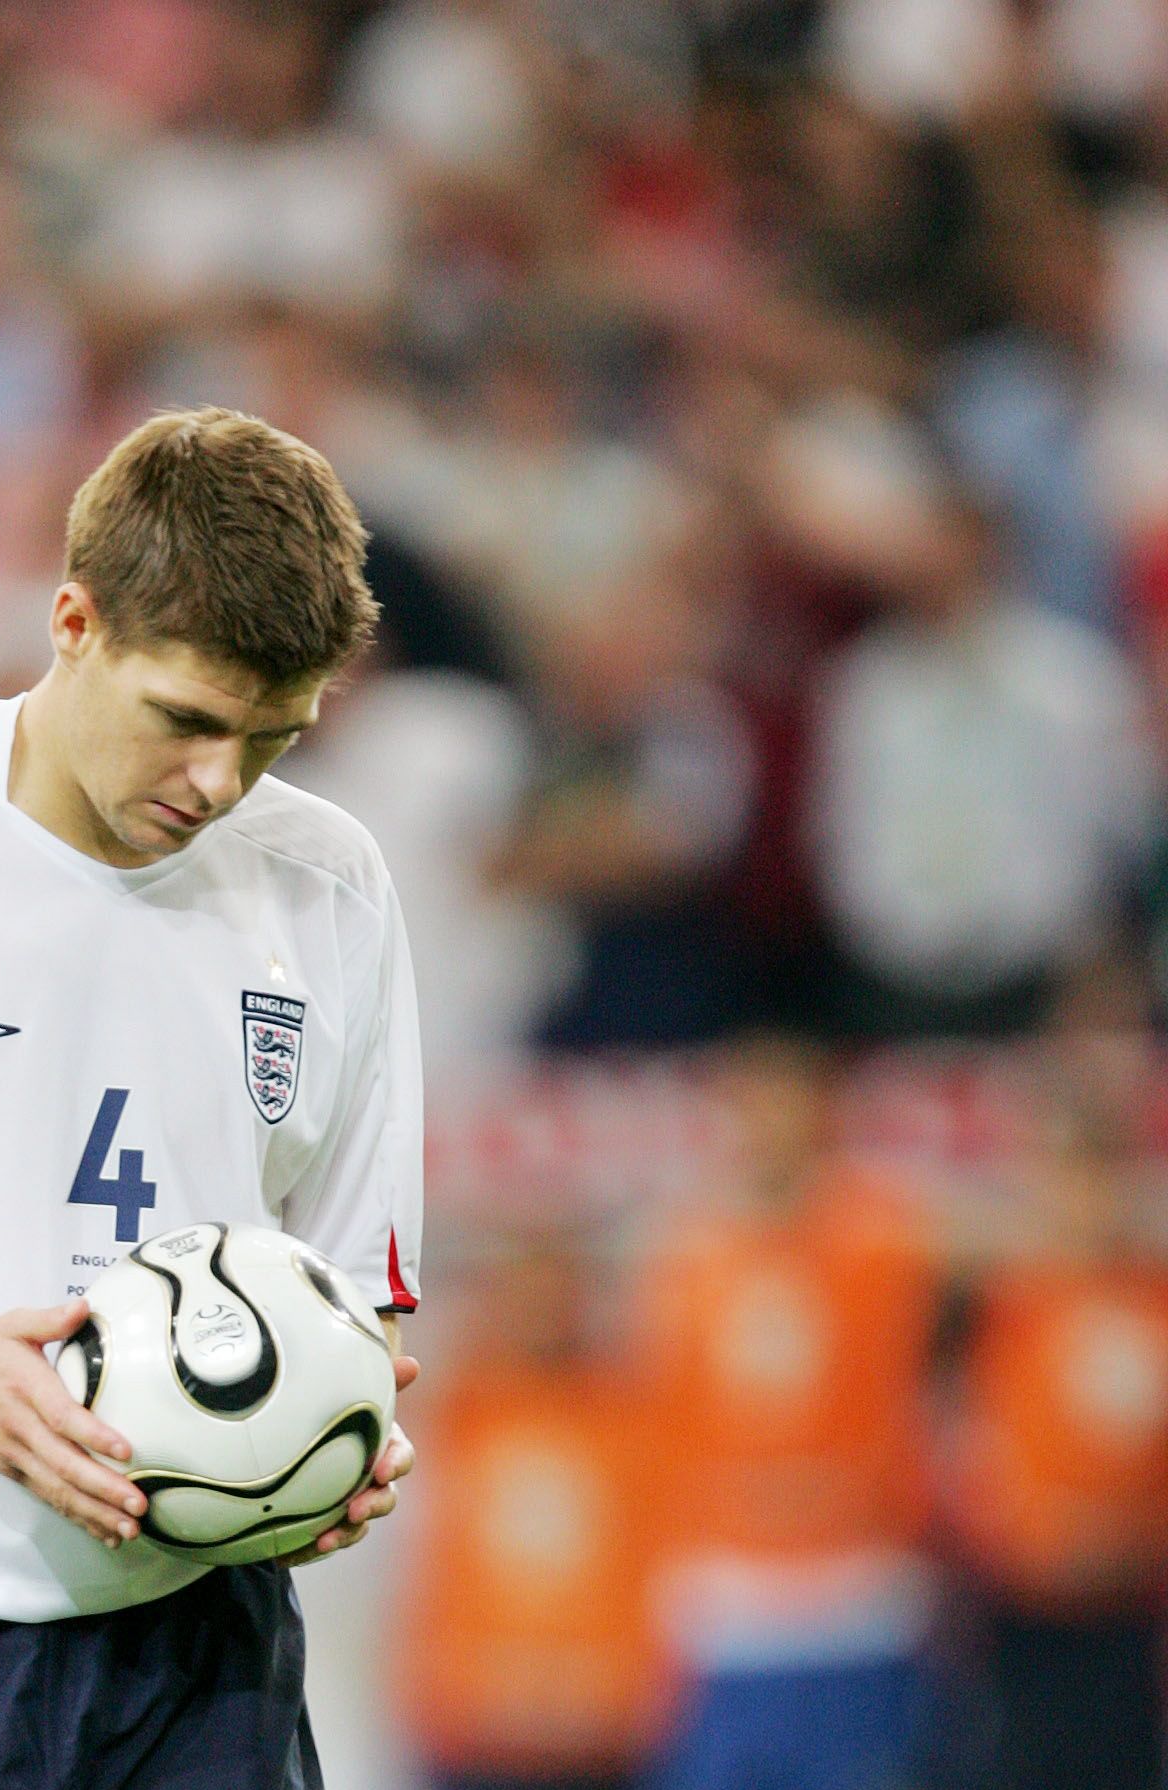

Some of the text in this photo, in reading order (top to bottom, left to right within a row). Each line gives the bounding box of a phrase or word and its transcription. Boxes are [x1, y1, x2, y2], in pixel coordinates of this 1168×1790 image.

[245, 994, 304, 1020] ENGLAND
[67, 1087, 157, 1243] 4
[71, 1254, 118, 1268] ENGL
